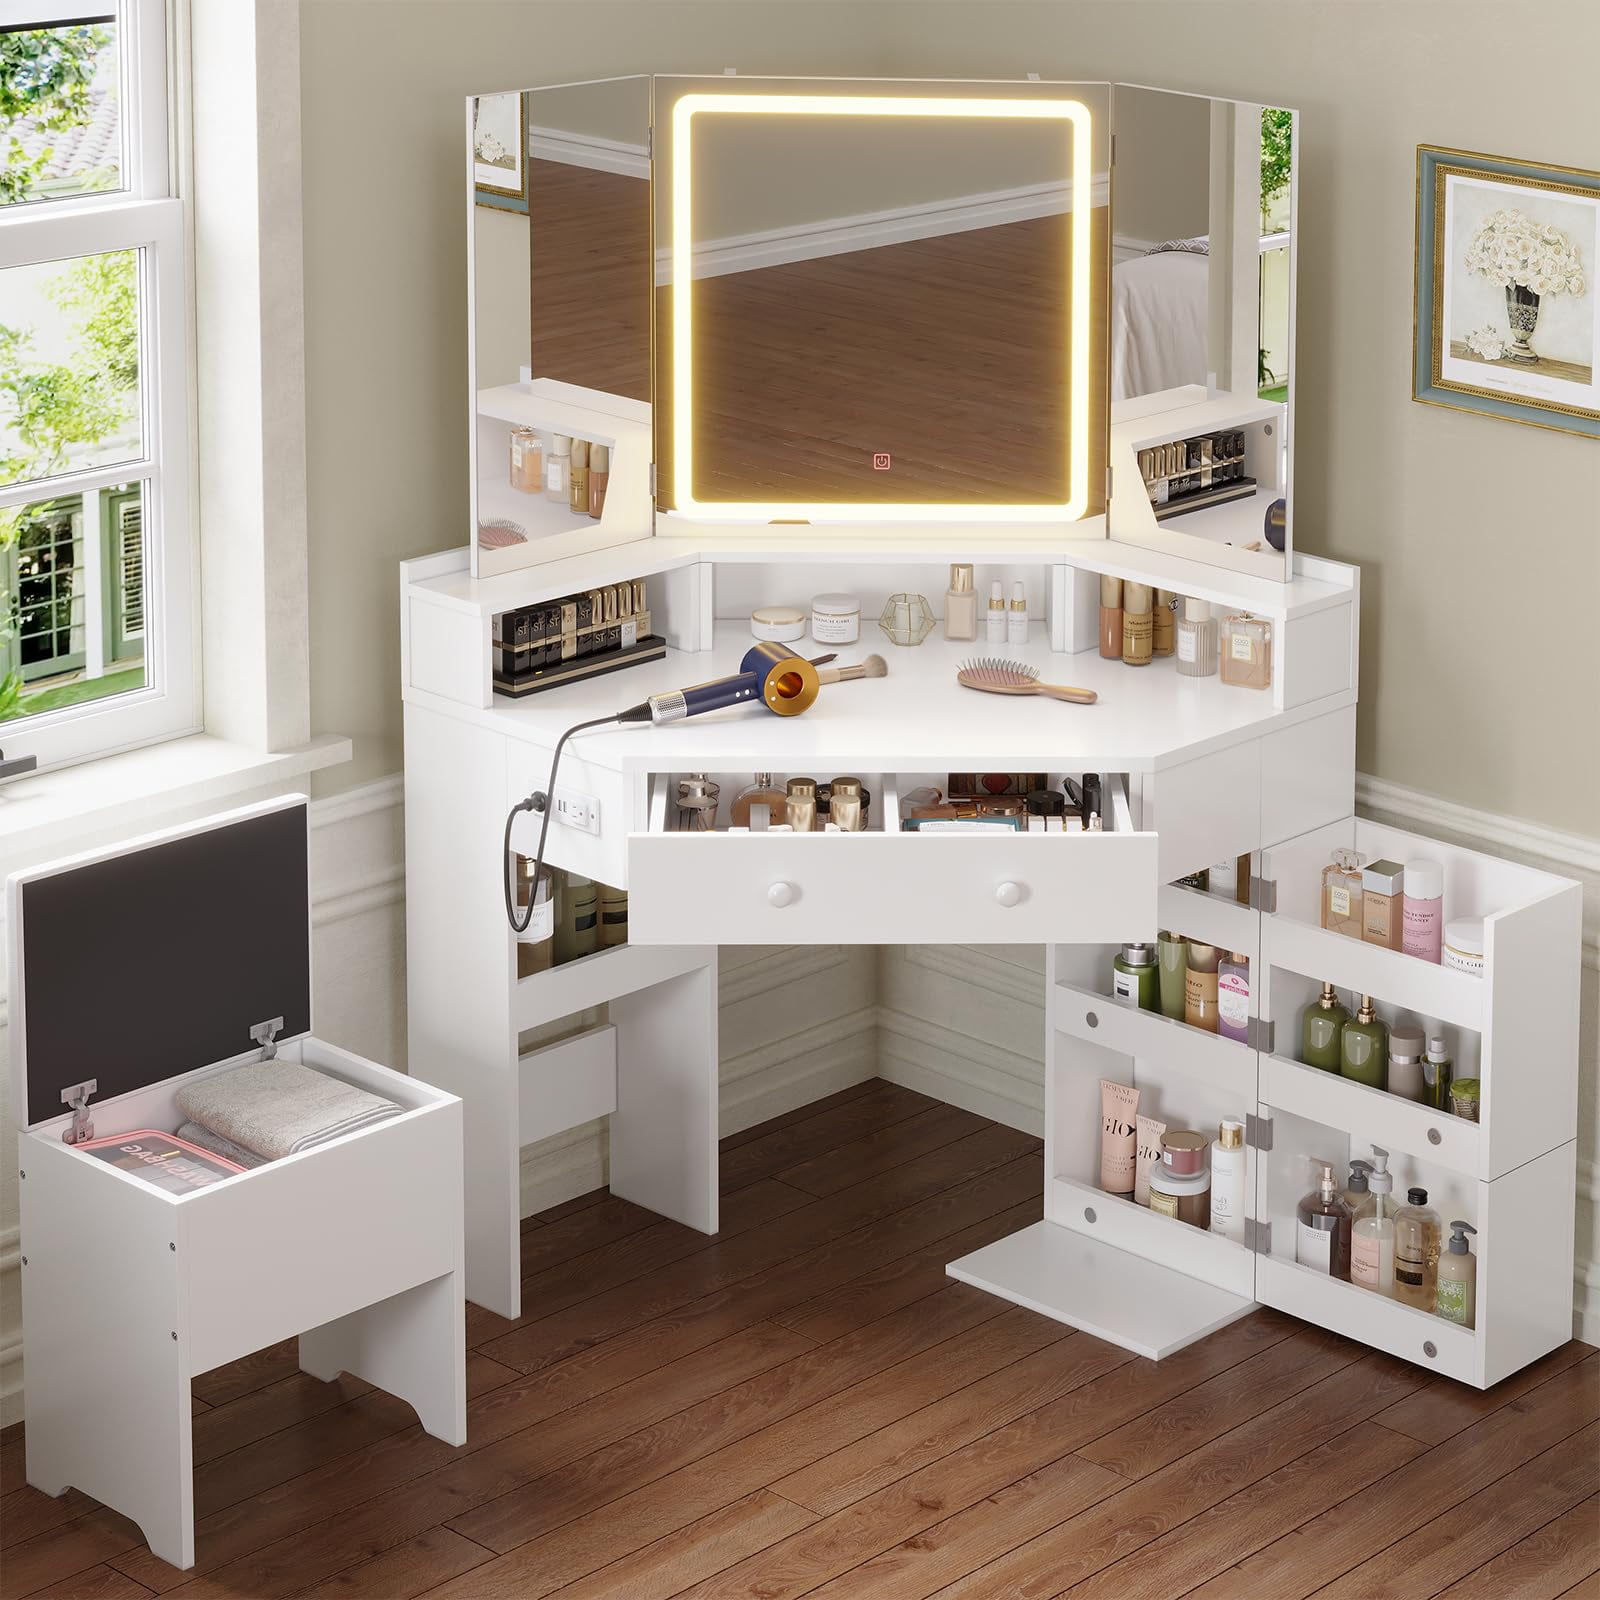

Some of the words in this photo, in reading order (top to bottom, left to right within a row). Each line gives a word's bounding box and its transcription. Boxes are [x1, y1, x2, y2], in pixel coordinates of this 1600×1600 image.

[580, 608, 591, 619] ST
[533, 621, 544, 631] ST
[549, 616, 560, 627] ST
[517, 624, 528, 635] ST
[610, 628, 621, 639] ST
[594, 632, 606, 643] ST
